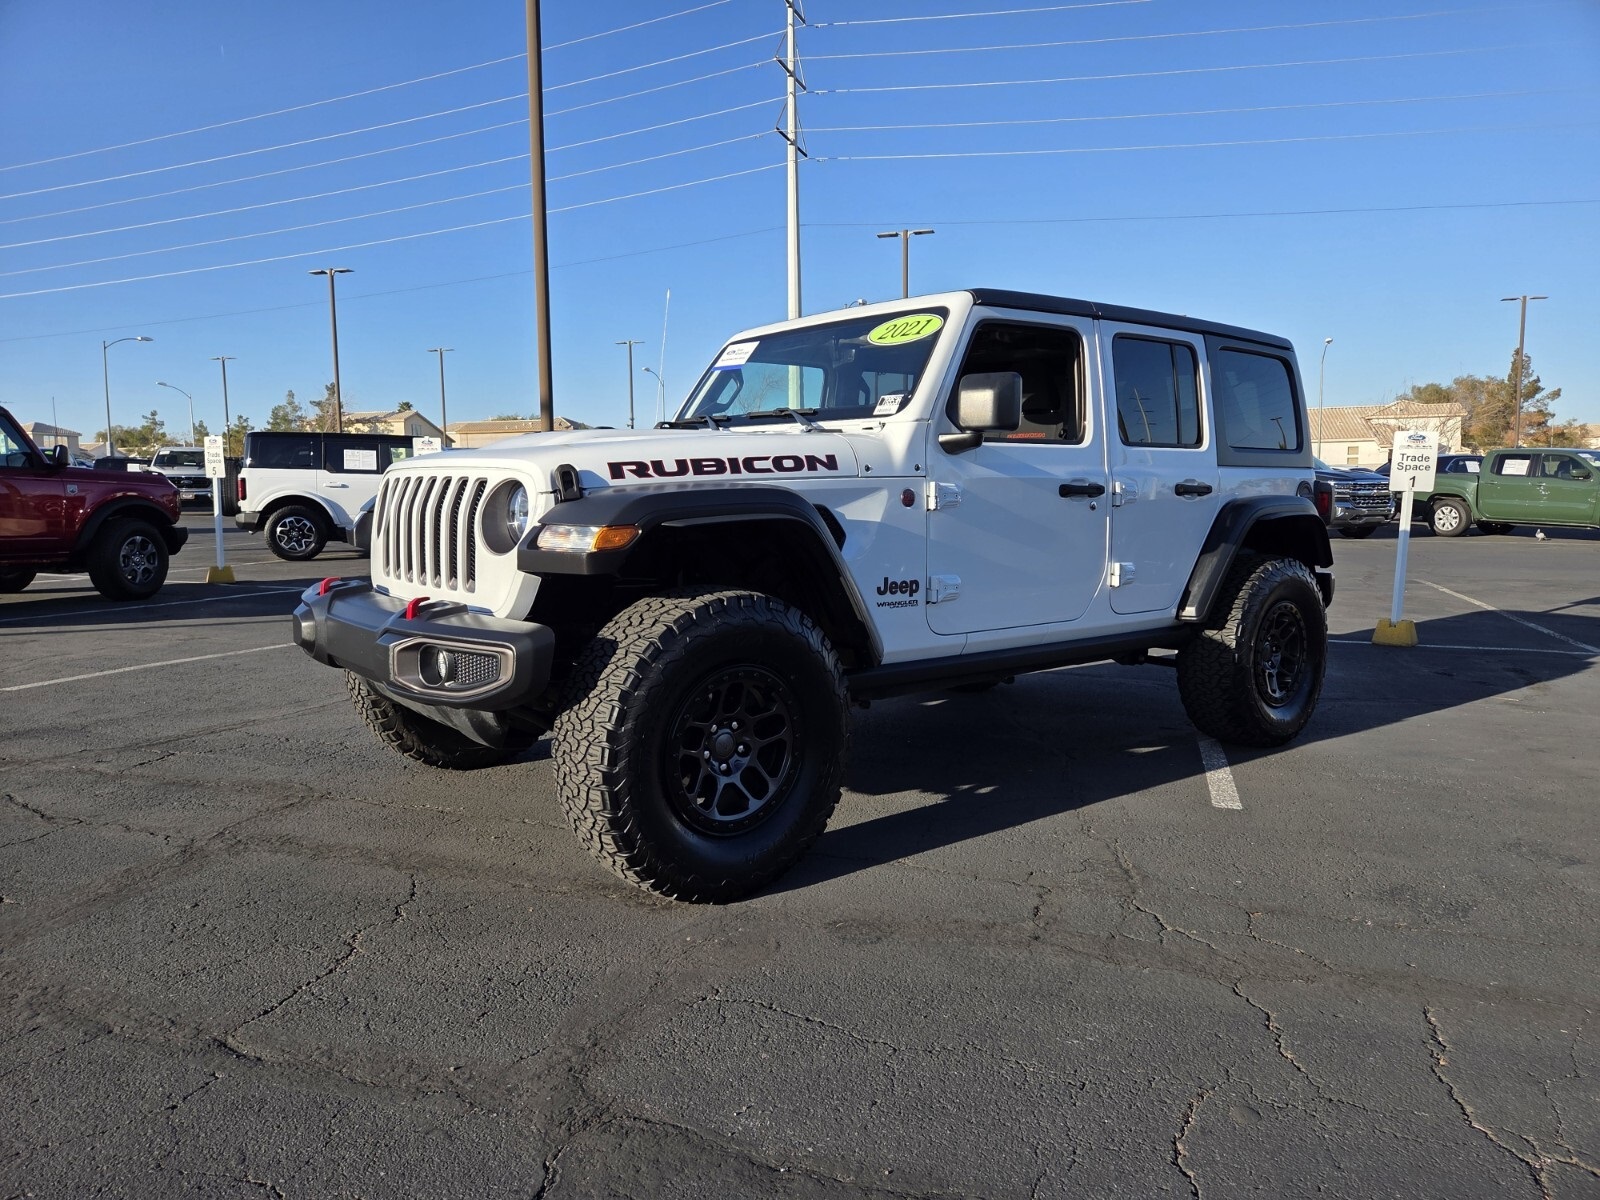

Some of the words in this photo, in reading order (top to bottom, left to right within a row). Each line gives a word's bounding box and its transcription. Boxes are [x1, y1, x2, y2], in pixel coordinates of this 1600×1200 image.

[877, 319, 933, 340] 2021
[1400, 453, 1430, 462] Trade
[212, 466, 217, 475] 5
[607, 454, 839, 480] RUBICON
[1397, 462, 1431, 472] Space
[1409, 475, 1416, 488] 1
[877, 576, 920, 597] Jeep
[877, 599, 918, 607] WRANGLER
